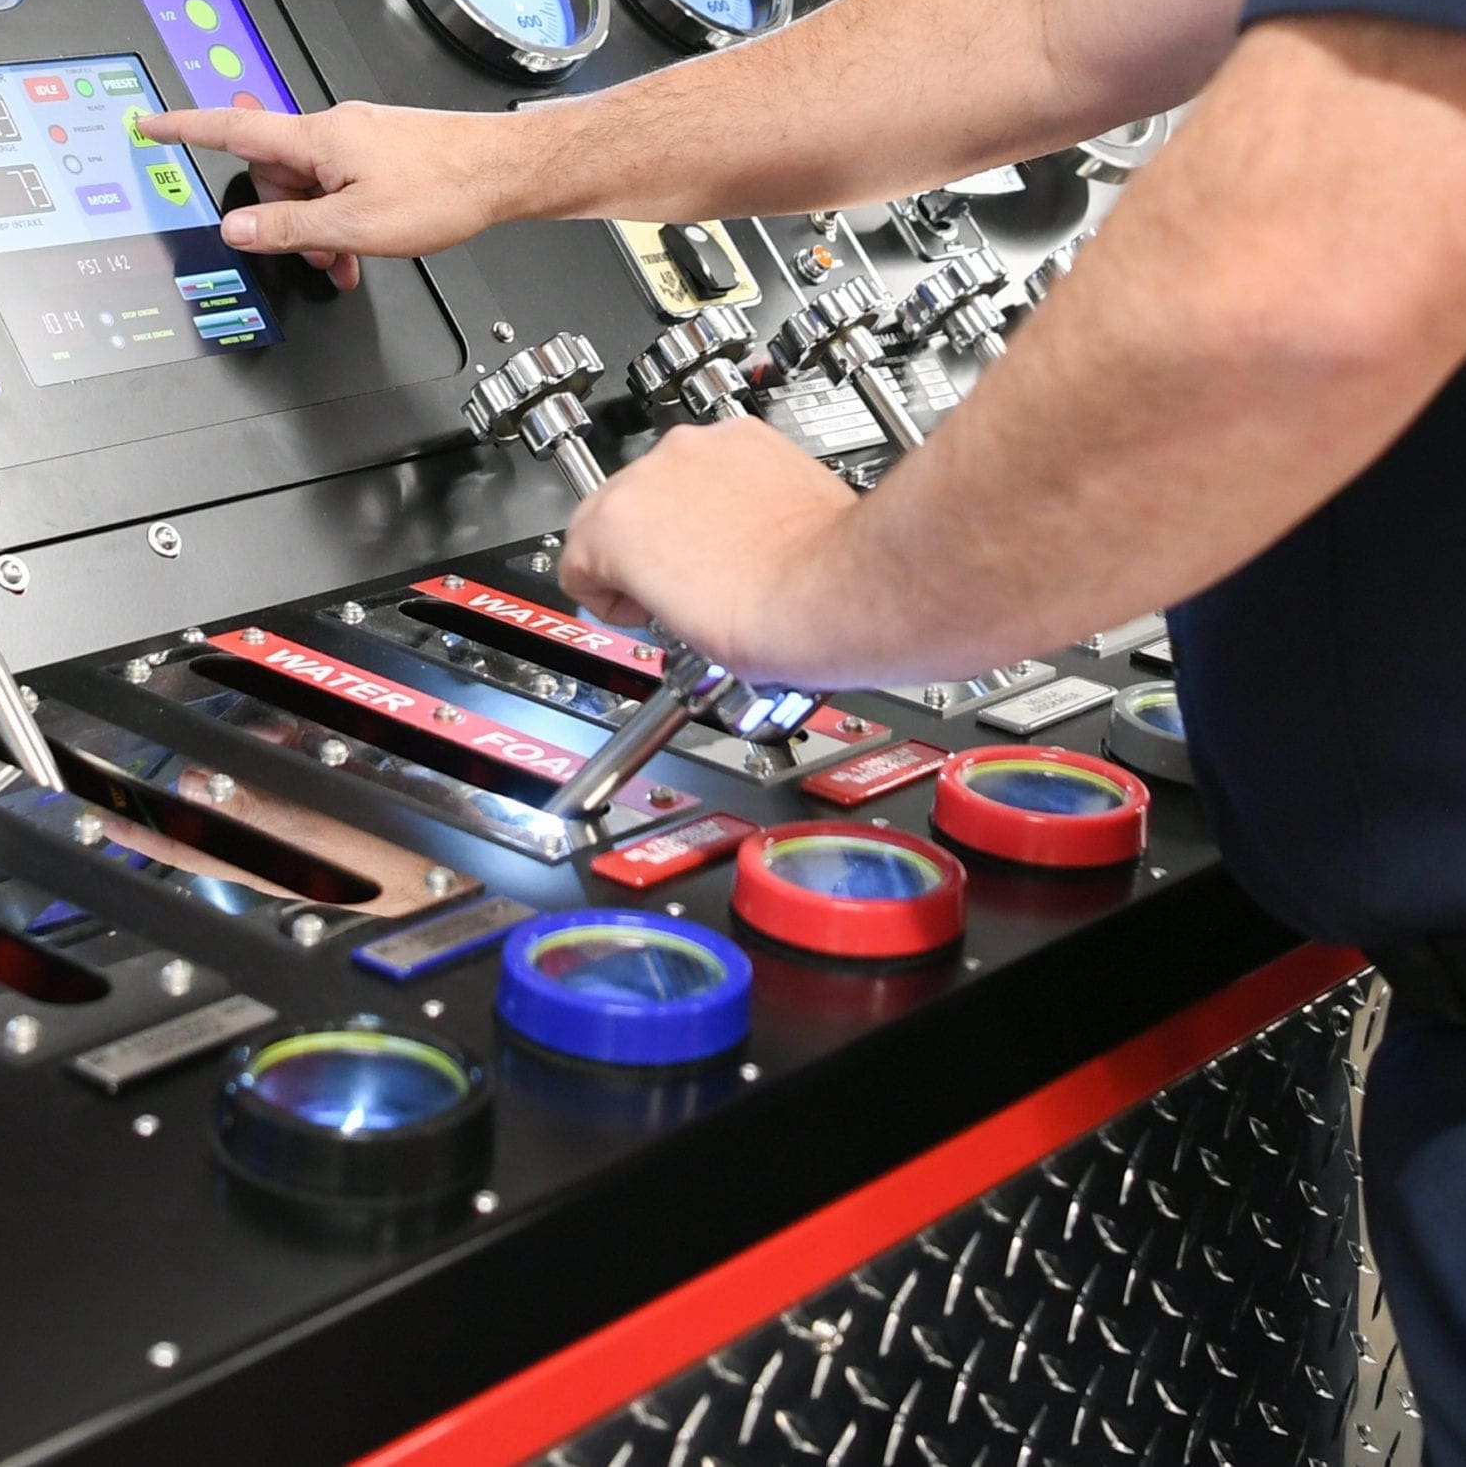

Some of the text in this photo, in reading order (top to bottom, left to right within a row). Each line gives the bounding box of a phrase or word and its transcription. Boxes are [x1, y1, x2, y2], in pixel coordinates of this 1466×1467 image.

[707, 0, 730, 13] 600
[160, 11, 177, 21] 1/2
[517, 15, 542, 28] 600
[184, 60, 201, 70] 1/4
[34, 84, 60, 96] IDLE
[103, 77, 139, 90] PRESET
[73, 125, 105, 133] PRESSURE
[154, 171, 181, 184] DEC
[6, 169, 52, 208] 73
[87, 193, 121, 206] MODE
[13, 218, 44, 229] INTAKE
[77, 254, 131, 276] PSI 142
[467, 593, 614, 650] WATER
[265, 648, 416, 712] WATER
[472, 730, 578, 779] FOA
